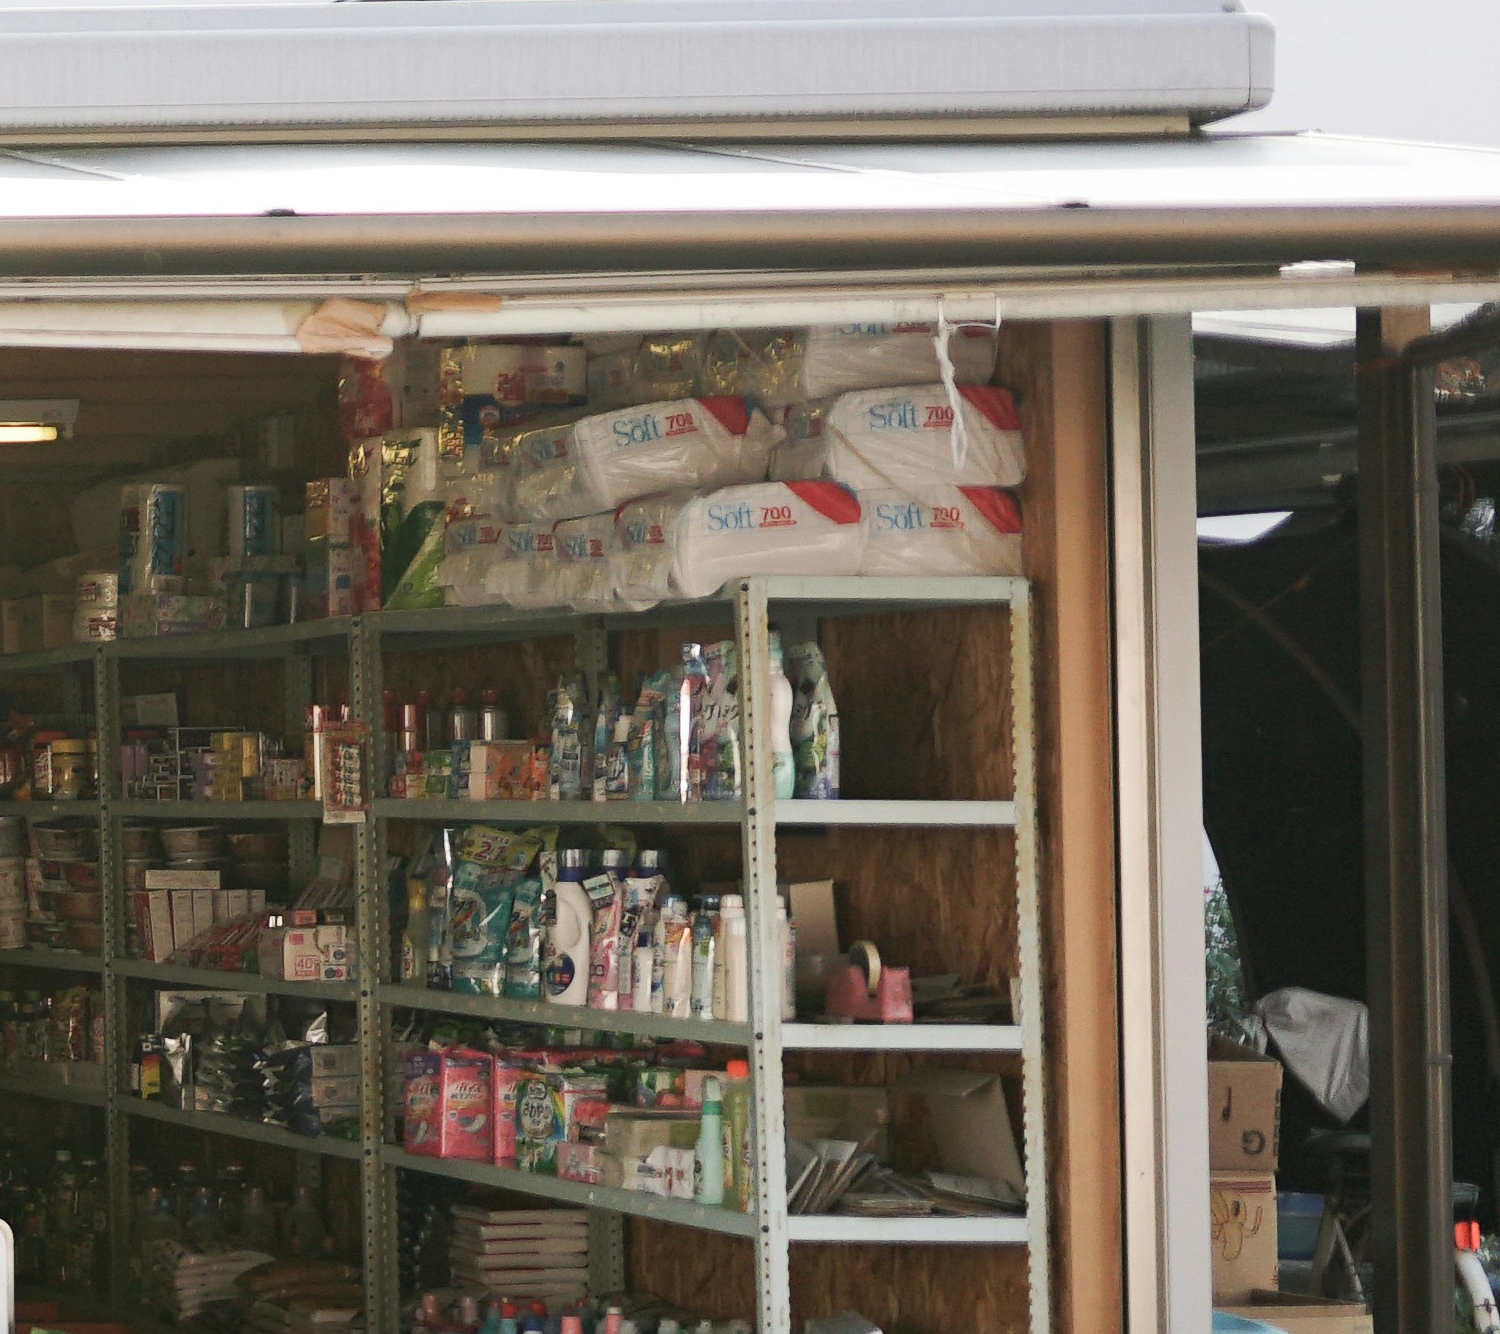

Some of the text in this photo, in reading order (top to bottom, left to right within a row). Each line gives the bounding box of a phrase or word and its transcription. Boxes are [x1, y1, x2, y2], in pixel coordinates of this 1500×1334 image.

[613, 414, 664, 447] Soft
[707, 505, 792, 531] Soft 700
[876, 503, 925, 530] Soft
